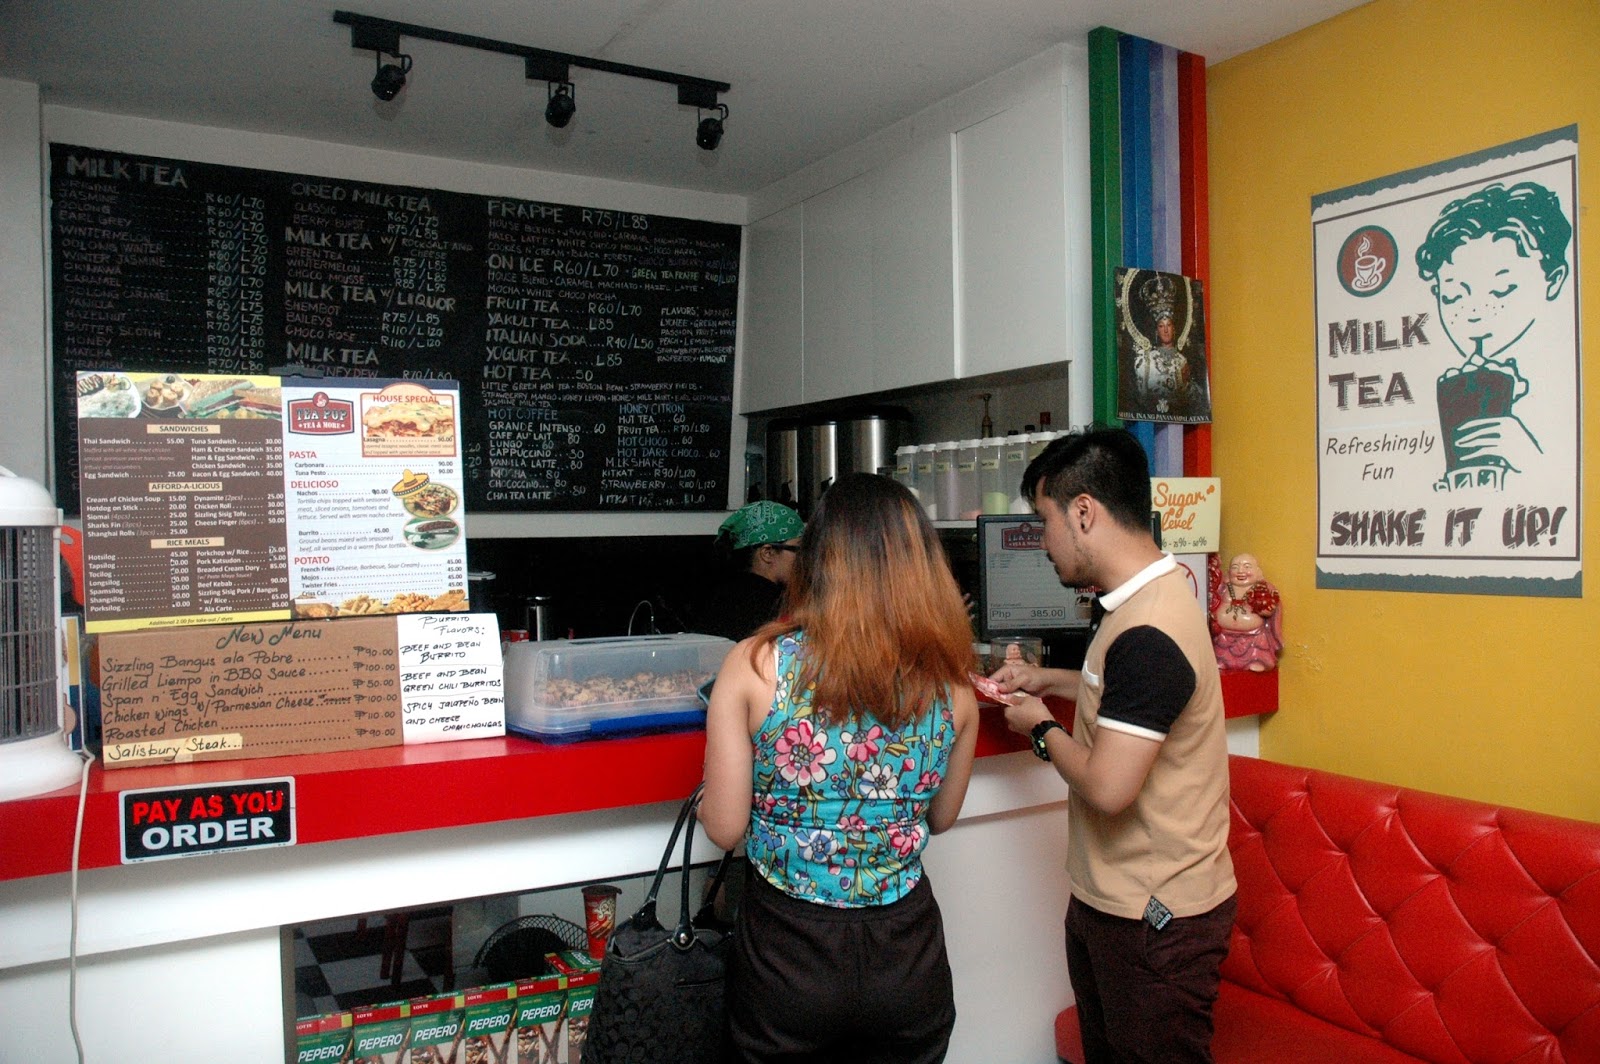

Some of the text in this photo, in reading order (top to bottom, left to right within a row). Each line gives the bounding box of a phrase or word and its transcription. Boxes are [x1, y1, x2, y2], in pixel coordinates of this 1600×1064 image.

[67, 155, 188, 189] MILK TEA
[291, 183, 346, 200] OREO
[488, 200, 563, 222] FRAPPE
[285, 226, 373, 250] MILK TEA
[286, 247, 342, 259] GREEN TEA
[287, 260, 360, 272] WINTERMELON
[488, 255, 514, 270] ON
[520, 258, 544, 273] ICE
[285, 281, 456, 312] MILK TEA LIQUOR
[486, 296, 529, 311] FRUIT
[533, 300, 560, 313] TEA
[488, 313, 570, 329] YAKULT TEA
[486, 328, 587, 347] ITALIAN SODA
[1328, 312, 1430, 359] MILK
[286, 342, 379, 365] MILK TEA
[486, 347, 538, 363] YOGURT
[542, 350, 570, 364] TEA
[483, 367, 551, 380] HOT TEA
[1329, 371, 1415, 411] TEA
[296, 408, 347, 421] TEA POP
[489, 422, 581, 433] GRANDE INTENSO
[1326, 431, 1435, 455] Refreshingly
[1362, 464, 1394, 480] Fun
[291, 480, 338, 488] DELICIOSO
[1330, 505, 1567, 549] SHAKE IT UP!
[216, 624, 321, 649] New Menu
[400, 644, 429, 655] BEEF
[102, 659, 154, 676] Sizzling
[160, 656, 215, 672] Bangus
[102, 676, 149, 692] Grilled
[210, 674, 220, 682] in
[224, 668, 262, 681] BBQ
[401, 673, 431, 681] BEEF
[404, 684, 434, 692] GREEN
[460, 680, 501, 688] BURRITOS
[102, 684, 263, 710] Spam Egg Sandwich
[404, 702, 432, 713] SPICY
[104, 710, 150, 724] Chicken
[105, 719, 218, 742] Roasted Chicken
[109, 744, 180, 761] Salisbury
[132, 790, 283, 825] PAY AS YOU
[142, 817, 275, 850] ORDER
[521, 1005, 560, 1020] PEPERO
[468, 1014, 510, 1031] PEPERO
[415, 1024, 457, 1041] PEPERO
[358, 1033, 402, 1051] PEPERO
[298, 1044, 344, 1062] PEPERO
